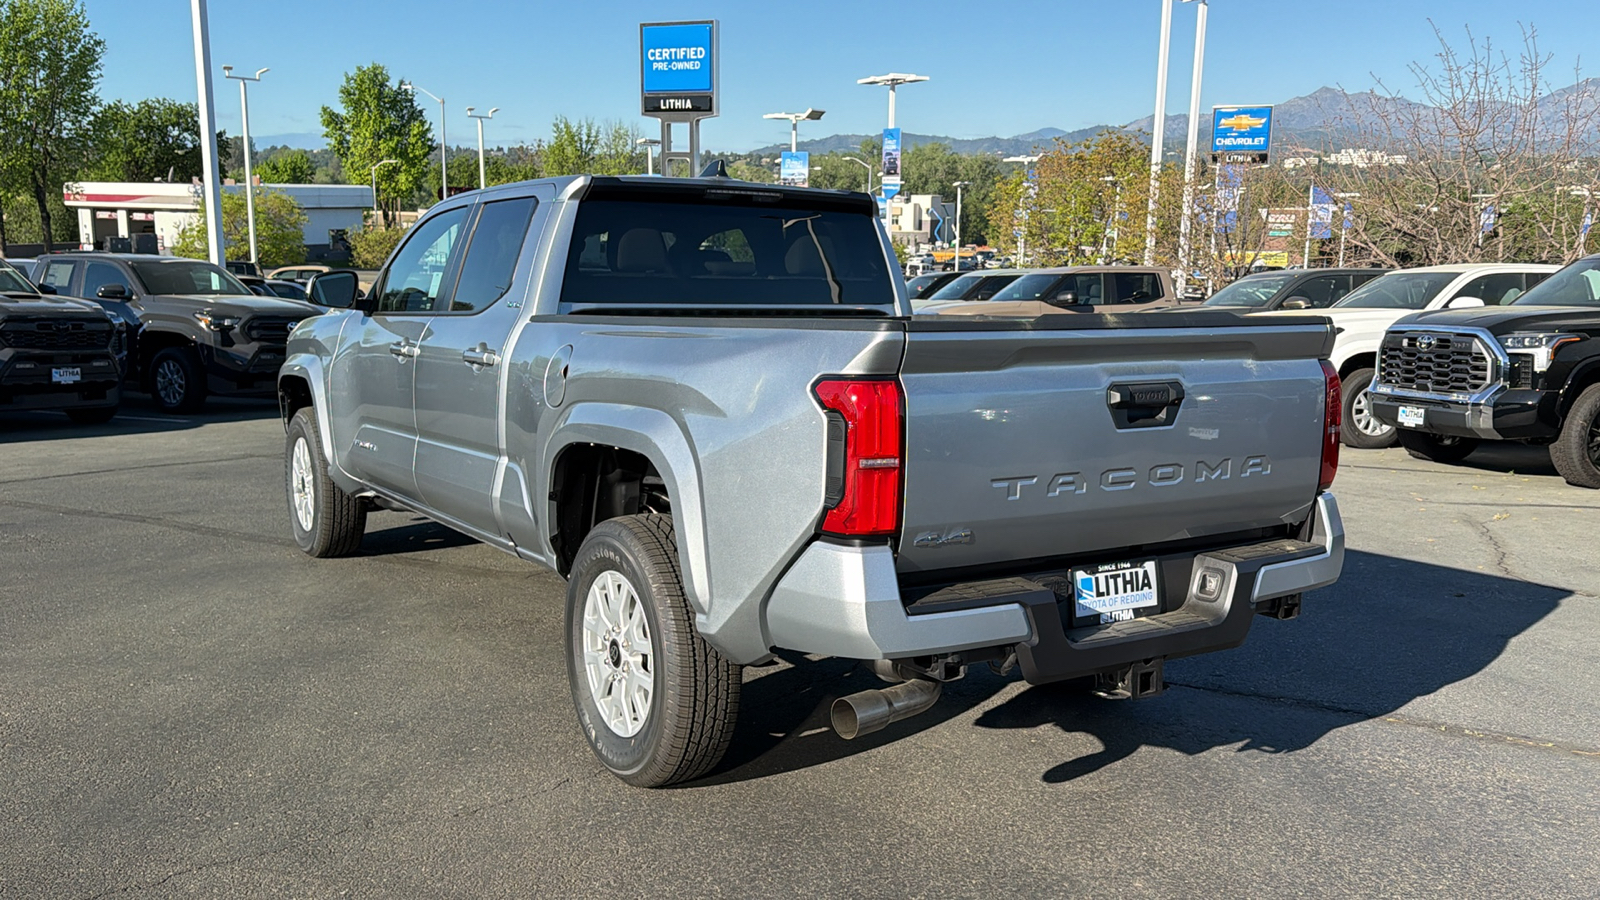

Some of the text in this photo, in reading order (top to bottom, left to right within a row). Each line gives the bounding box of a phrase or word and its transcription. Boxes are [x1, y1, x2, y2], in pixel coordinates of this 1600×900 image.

[647, 47, 705, 60] CERTIFIED
[652, 61, 701, 71] PRE-OWNED
[660, 98, 692, 109] LITHIA
[1215, 137, 1266, 146] CHEVROLET
[59, 369, 80, 378] LITHIA
[1134, 389, 1168, 400] TOYOTA
[990, 454, 1271, 501] TACOMA
[1098, 562, 1116, 572] SINCE
[1094, 569, 1152, 598] LITHIA
[1078, 591, 1153, 612] TOYOTA OF REDDING
[1108, 608, 1135, 622] LITHIA
